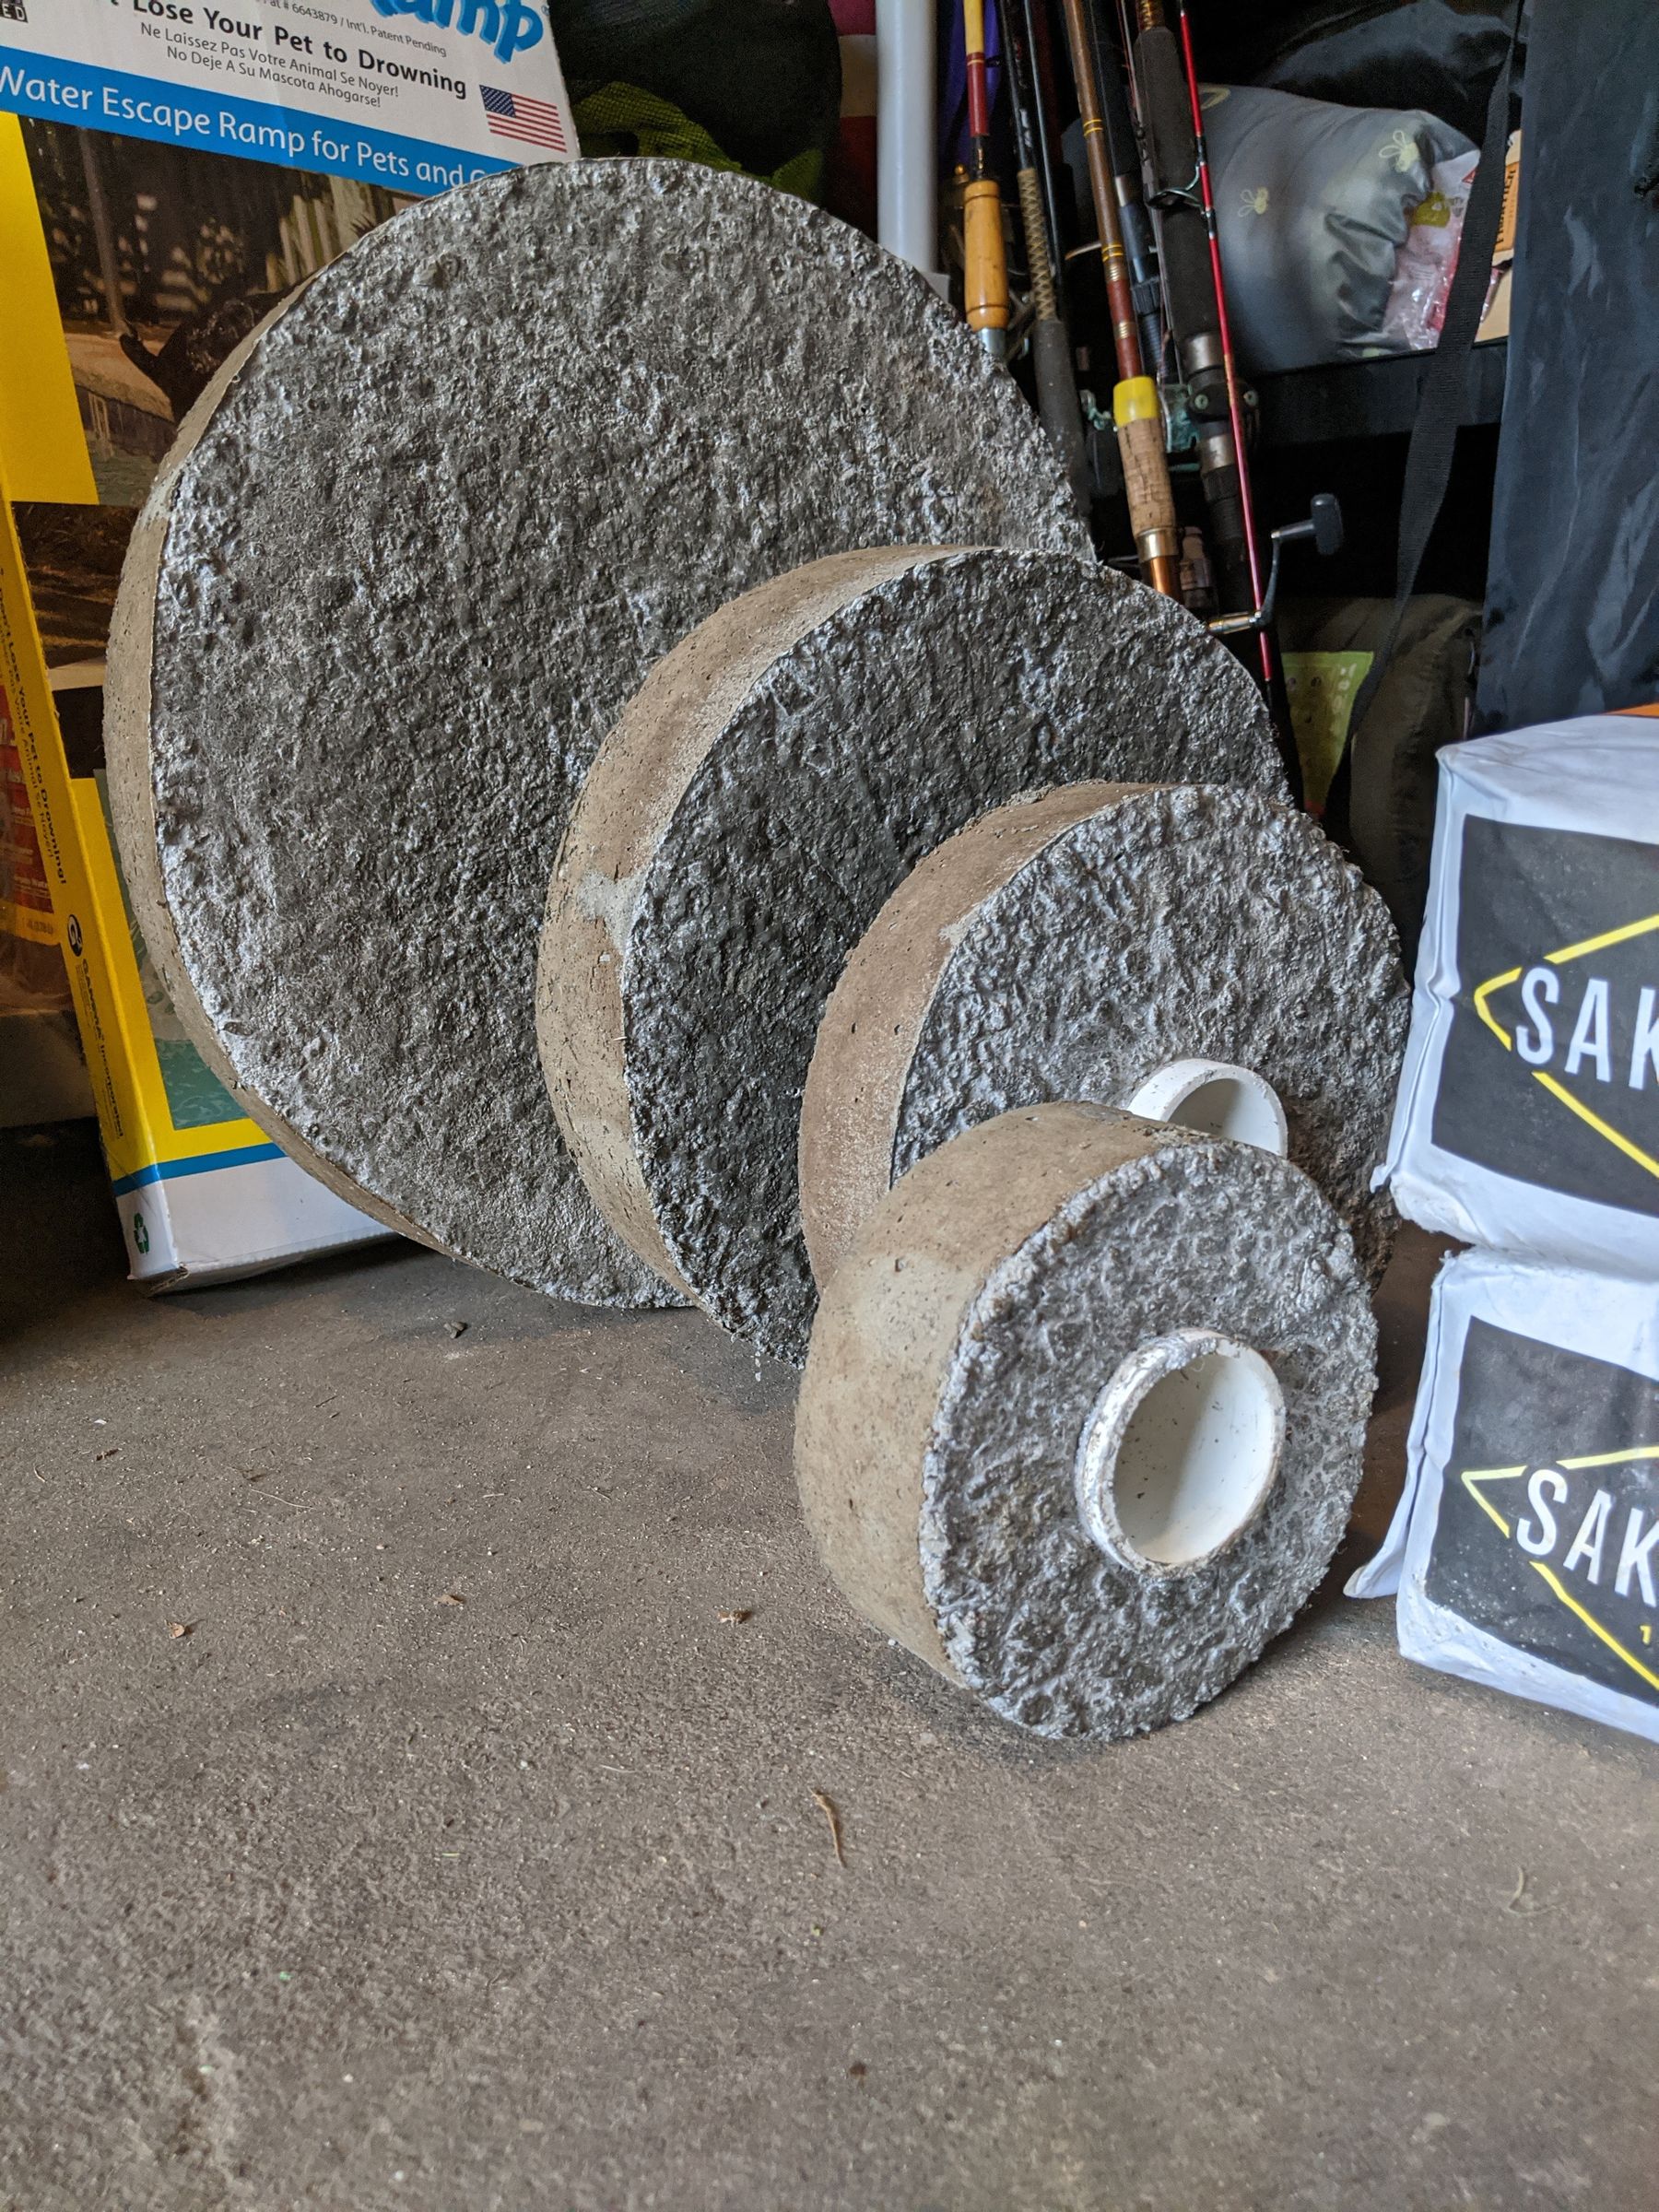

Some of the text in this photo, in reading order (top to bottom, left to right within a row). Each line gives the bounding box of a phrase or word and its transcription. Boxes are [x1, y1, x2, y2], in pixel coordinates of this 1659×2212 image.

[133, 0, 466, 100] Lose Your Pet to Drowning
[141, 22, 399, 97] Ne Laissez Pas Votre Animal Se Noyer!
[292, 4, 338, 24] 6643879
[371, 25, 405, 44] Patent
[406, 35, 447, 57] Pending
[373, 0, 544, 65] amp
[167, 46, 382, 107] No Deje A Su Mascota Ahogarse!
[0, 65, 463, 187] Water Escape Ramp for Pets and
[18, 685, 30, 726] Your
[29, 732, 38, 759] Pet
[1516, 967, 1659, 1090] SAK
[1516, 1469, 1659, 1608] SAK
